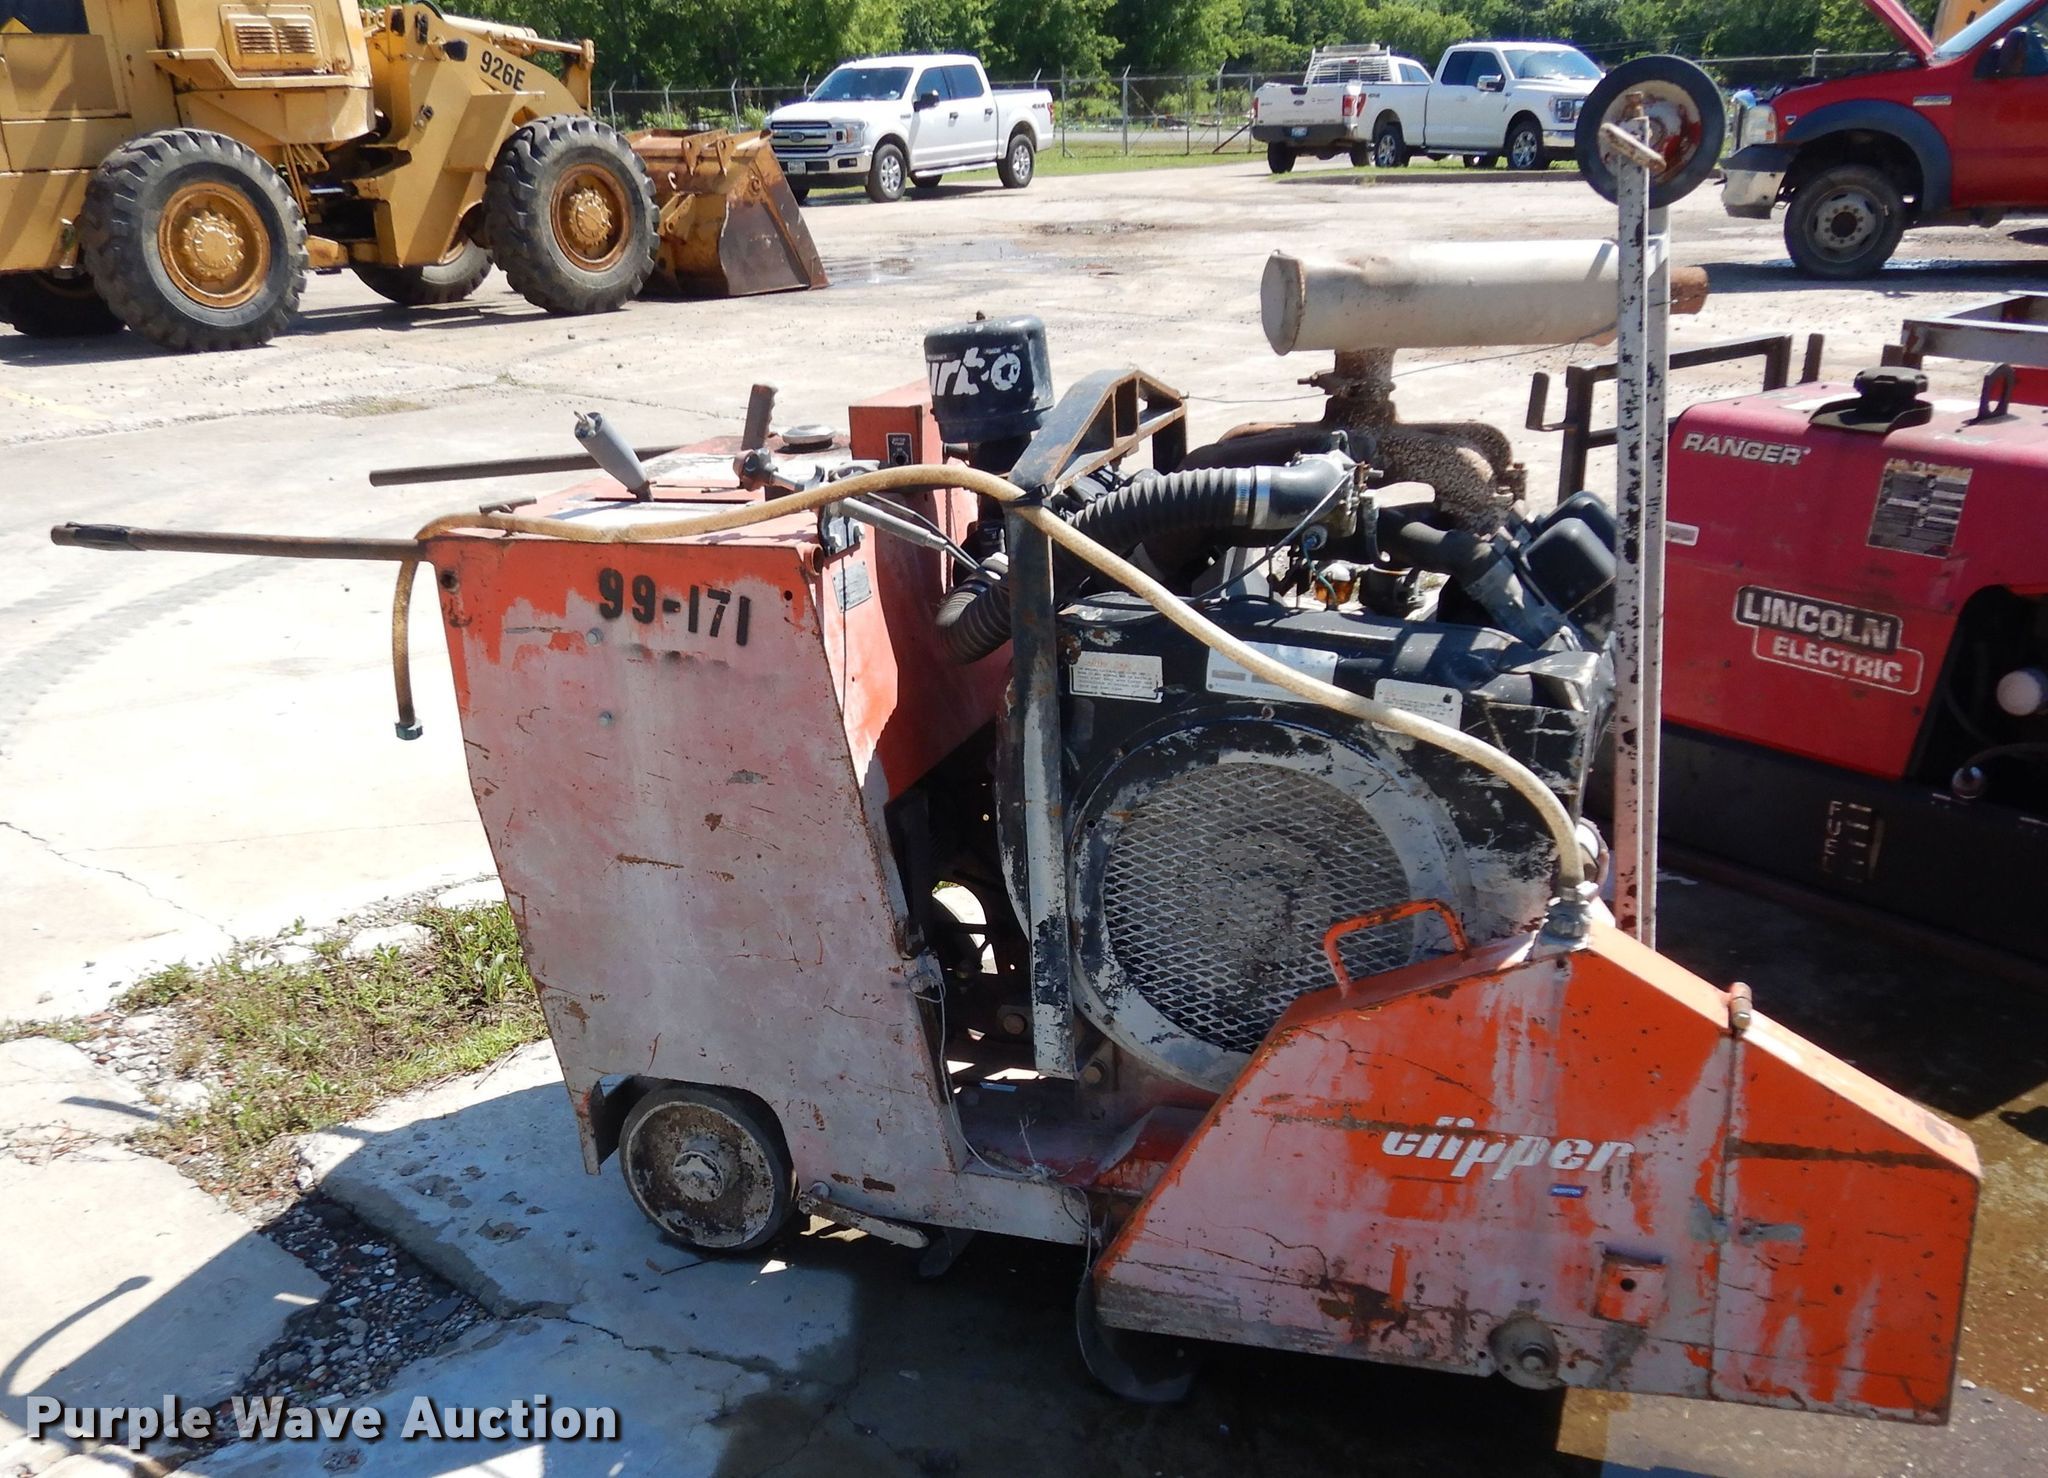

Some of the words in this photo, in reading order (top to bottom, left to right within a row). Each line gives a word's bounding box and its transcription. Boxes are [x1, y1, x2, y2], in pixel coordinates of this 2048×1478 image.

[480, 50, 526, 91] 926E
[1682, 432, 1803, 466] RANGER
[598, 567, 751, 646] 99-171
[1742, 591, 1892, 650] LINCOLN
[1771, 635, 1904, 684] ELECTRIC
